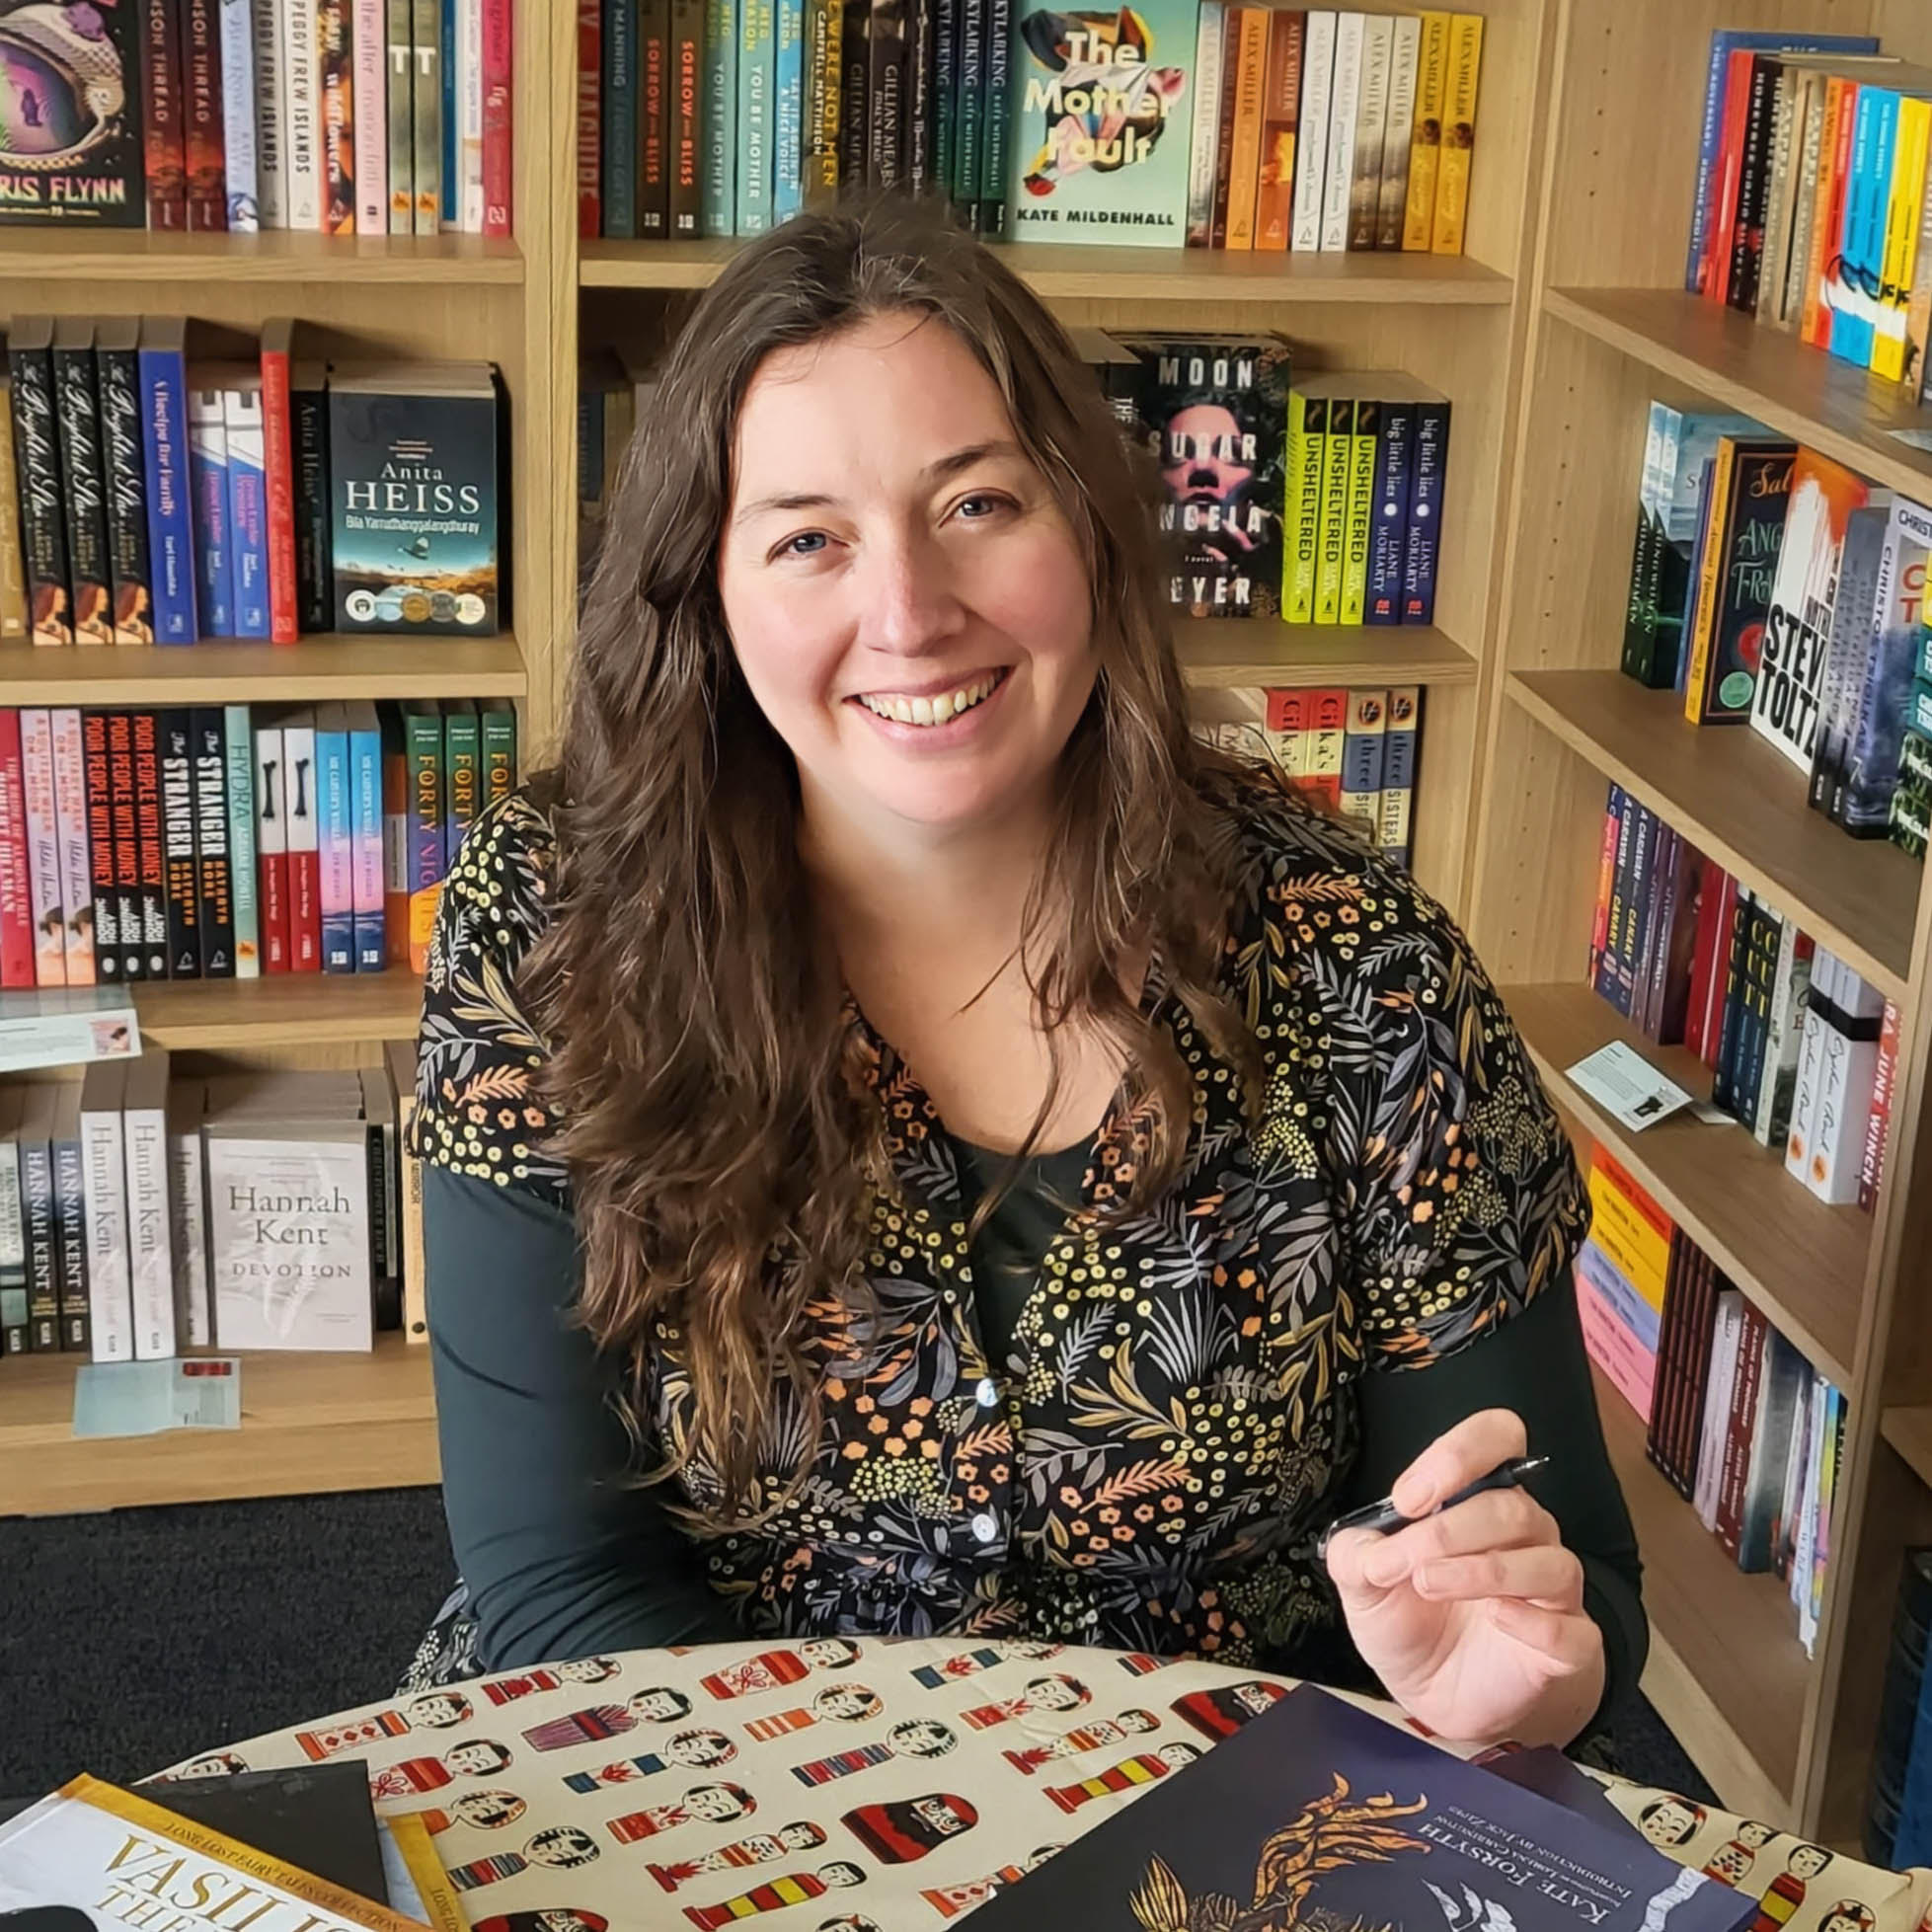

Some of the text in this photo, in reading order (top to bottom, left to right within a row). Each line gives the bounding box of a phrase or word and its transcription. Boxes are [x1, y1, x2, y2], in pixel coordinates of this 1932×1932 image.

[613, 8, 626, 87] MANNING
[758, 6, 771, 39] MEG
[991, 0, 1008, 88] KYLARKING
[1065, 31, 1140, 67] The
[259, 0, 277, 173] PEGGY FREW ISLANDS
[291, 2, 310, 174] PEGGY FREW ISLANDS
[388, 44, 411, 74] T
[415, 45, 436, 75] T
[812, 10, 826, 156] CAMPBELL MATTINSON
[1243, 24, 1261, 117] ALEX MILLER
[1363, 34, 1386, 128] ALEX MILLER
[1392, 34, 1412, 128] ALEX MILLER
[1424, 21, 1442, 114] ALEX MILLER
[1454, 25, 1475, 117] ALEX MILLER
[327, 73, 343, 184] wildflowers
[647, 38, 659, 184] SORROW BLISS
[680, 40, 694, 188] SORROW BLISS
[713, 62, 725, 197] YOU BE MOTHER
[748, 63, 762, 198] YOU BE MOTHER
[780, 99, 789, 140] NICE
[822, 20, 839, 187] WERE NOT MEN
[882, 64, 897, 188] GILLIAN MEARS
[1024, 78, 1172, 117] Mother
[0, 176, 125, 204] RIS FLYNN
[779, 143, 789, 181] VOICE
[990, 123, 1001, 189] MILDENHALL
[1017, 208, 1175, 226] KATE MILDENHALL
[1158, 356, 1253, 388] MOON
[105, 383, 137, 472] Brightest
[153, 391, 170, 442] Recipe
[1148, 430, 1258, 462] SUGAR
[156, 443, 172, 467] for
[380, 461, 444, 481] Anita
[1385, 418, 1406, 497] big little lies
[1418, 419, 1438, 498] big little lies
[157, 468, 174, 517] Family
[345, 480, 481, 514] HEISS
[1297, 436, 1321, 562] UNSHELTERED
[1324, 437, 1348, 563] UNSHELTERED
[1350, 438, 1373, 564] UNSHELTERED
[34, 520, 46, 577] HARCOURT
[1372, 524, 1389, 593] MORIARTY
[1386, 539, 1399, 579] LIANE
[1405, 525, 1421, 593] MORIARTY
[1418, 540, 1432, 580] LIANE
[1629, 518, 1649, 624] SONGWOMAN
[1644, 527, 1664, 635] SONGWOMAN
[1318, 697, 1341, 771] Cilka's
[1757, 658, 1821, 759] TOLTZ
[164, 732, 192, 857] The STRANGER
[197, 730, 225, 855] The STRANGER
[454, 752, 473, 830] FORTY
[490, 752, 509, 802] FOR
[1357, 738, 1376, 787] three
[1384, 734, 1409, 846] three SISTERS
[85, 717, 113, 888] POOR PEOPLE WITH MONEY
[110, 717, 137, 887] POOR PEOPLE WITH MONEY
[133, 716, 161, 887] POOR PEOPLE WITH MONEY
[6, 756, 28, 928] THE BRIDE OF ALMOND TREE
[1607, 797, 1633, 951] A CARAVAN CANARY
[170, 862, 182, 900] HORE
[181, 862, 193, 926] KATHRYN
[202, 861, 215, 899] HORE
[214, 861, 227, 924] KATHRYN
[1623, 808, 1649, 965] A CARAVAN CANARY
[94, 896, 108, 945] DOMINIC
[105, 913, 116, 945] HOEY
[118, 896, 132, 944] DOMINIC
[129, 913, 141, 944] HOEY
[143, 895, 157, 943] DOMINIC
[154, 912, 166, 944] HOEY
[1873, 1044, 1893, 1103] JUNE
[1861, 1112, 1884, 1185] WINCH
[28, 1150, 50, 1290] HANNAH KENT
[60, 1149, 83, 1287] HANNAH KENT
[90, 1125, 116, 1256] Hannah Kent
[133, 1123, 160, 1254] Hannah Kent
[228, 1186, 351, 1213] Hannah
[255, 1219, 329, 1245] Kent
[231, 1262, 351, 1277] DEVOTION
[1417, 1822, 1536, 1888] FORSYTH
[1485, 1819, 1515, 1842] JACK
[1518, 1836, 1536, 1850] BY
[105, 1833, 348, 1932] VASIL
[164, 1821, 199, 1845] LONG
[204, 1837, 236, 1860] LOST
[237, 1851, 280, 1880] FAIRY
[314, 1885, 404, 1932] COLLECTION
[1536, 1845, 1634, 1900] INTRODUCTION
[1536, 1879, 1612, 1926] KATE
[93, 1886, 197, 1932] THE
